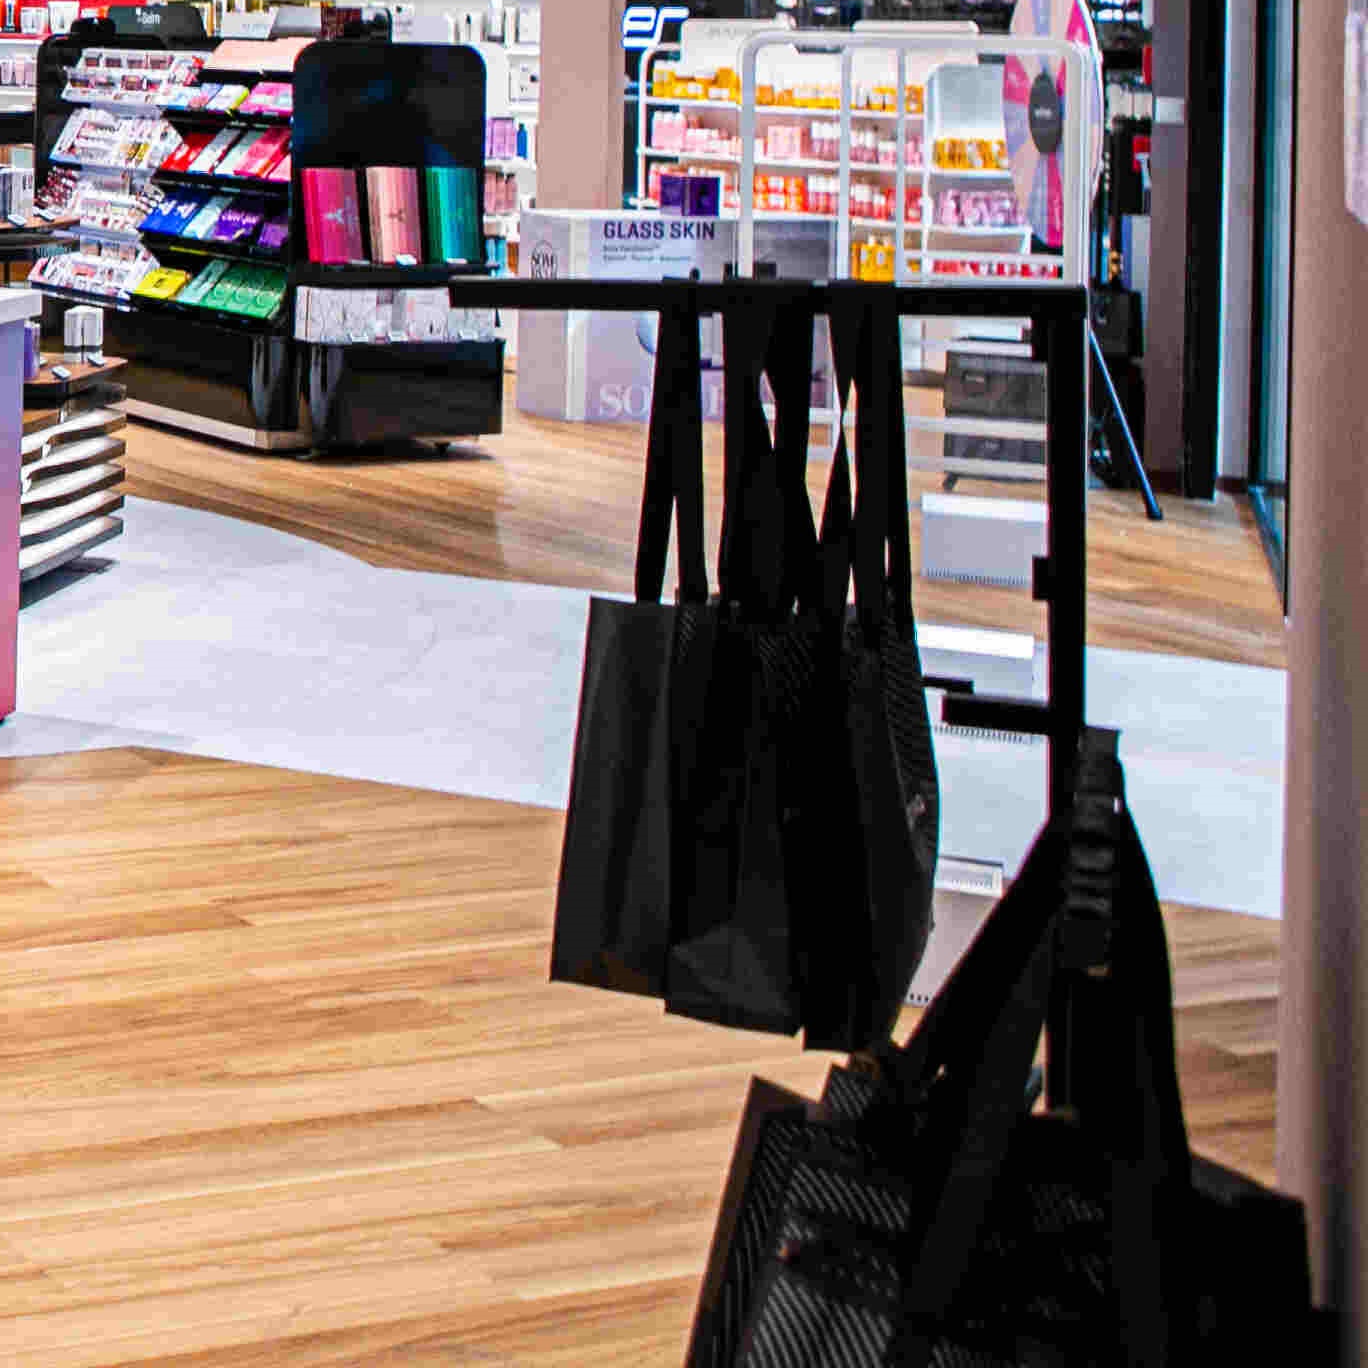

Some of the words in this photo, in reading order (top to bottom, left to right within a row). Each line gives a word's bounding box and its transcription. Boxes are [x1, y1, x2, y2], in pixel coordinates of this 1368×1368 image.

[622, 5, 690, 49] er
[603, 220, 665, 240] GLASS
[669, 221, 716, 241] SKIN
